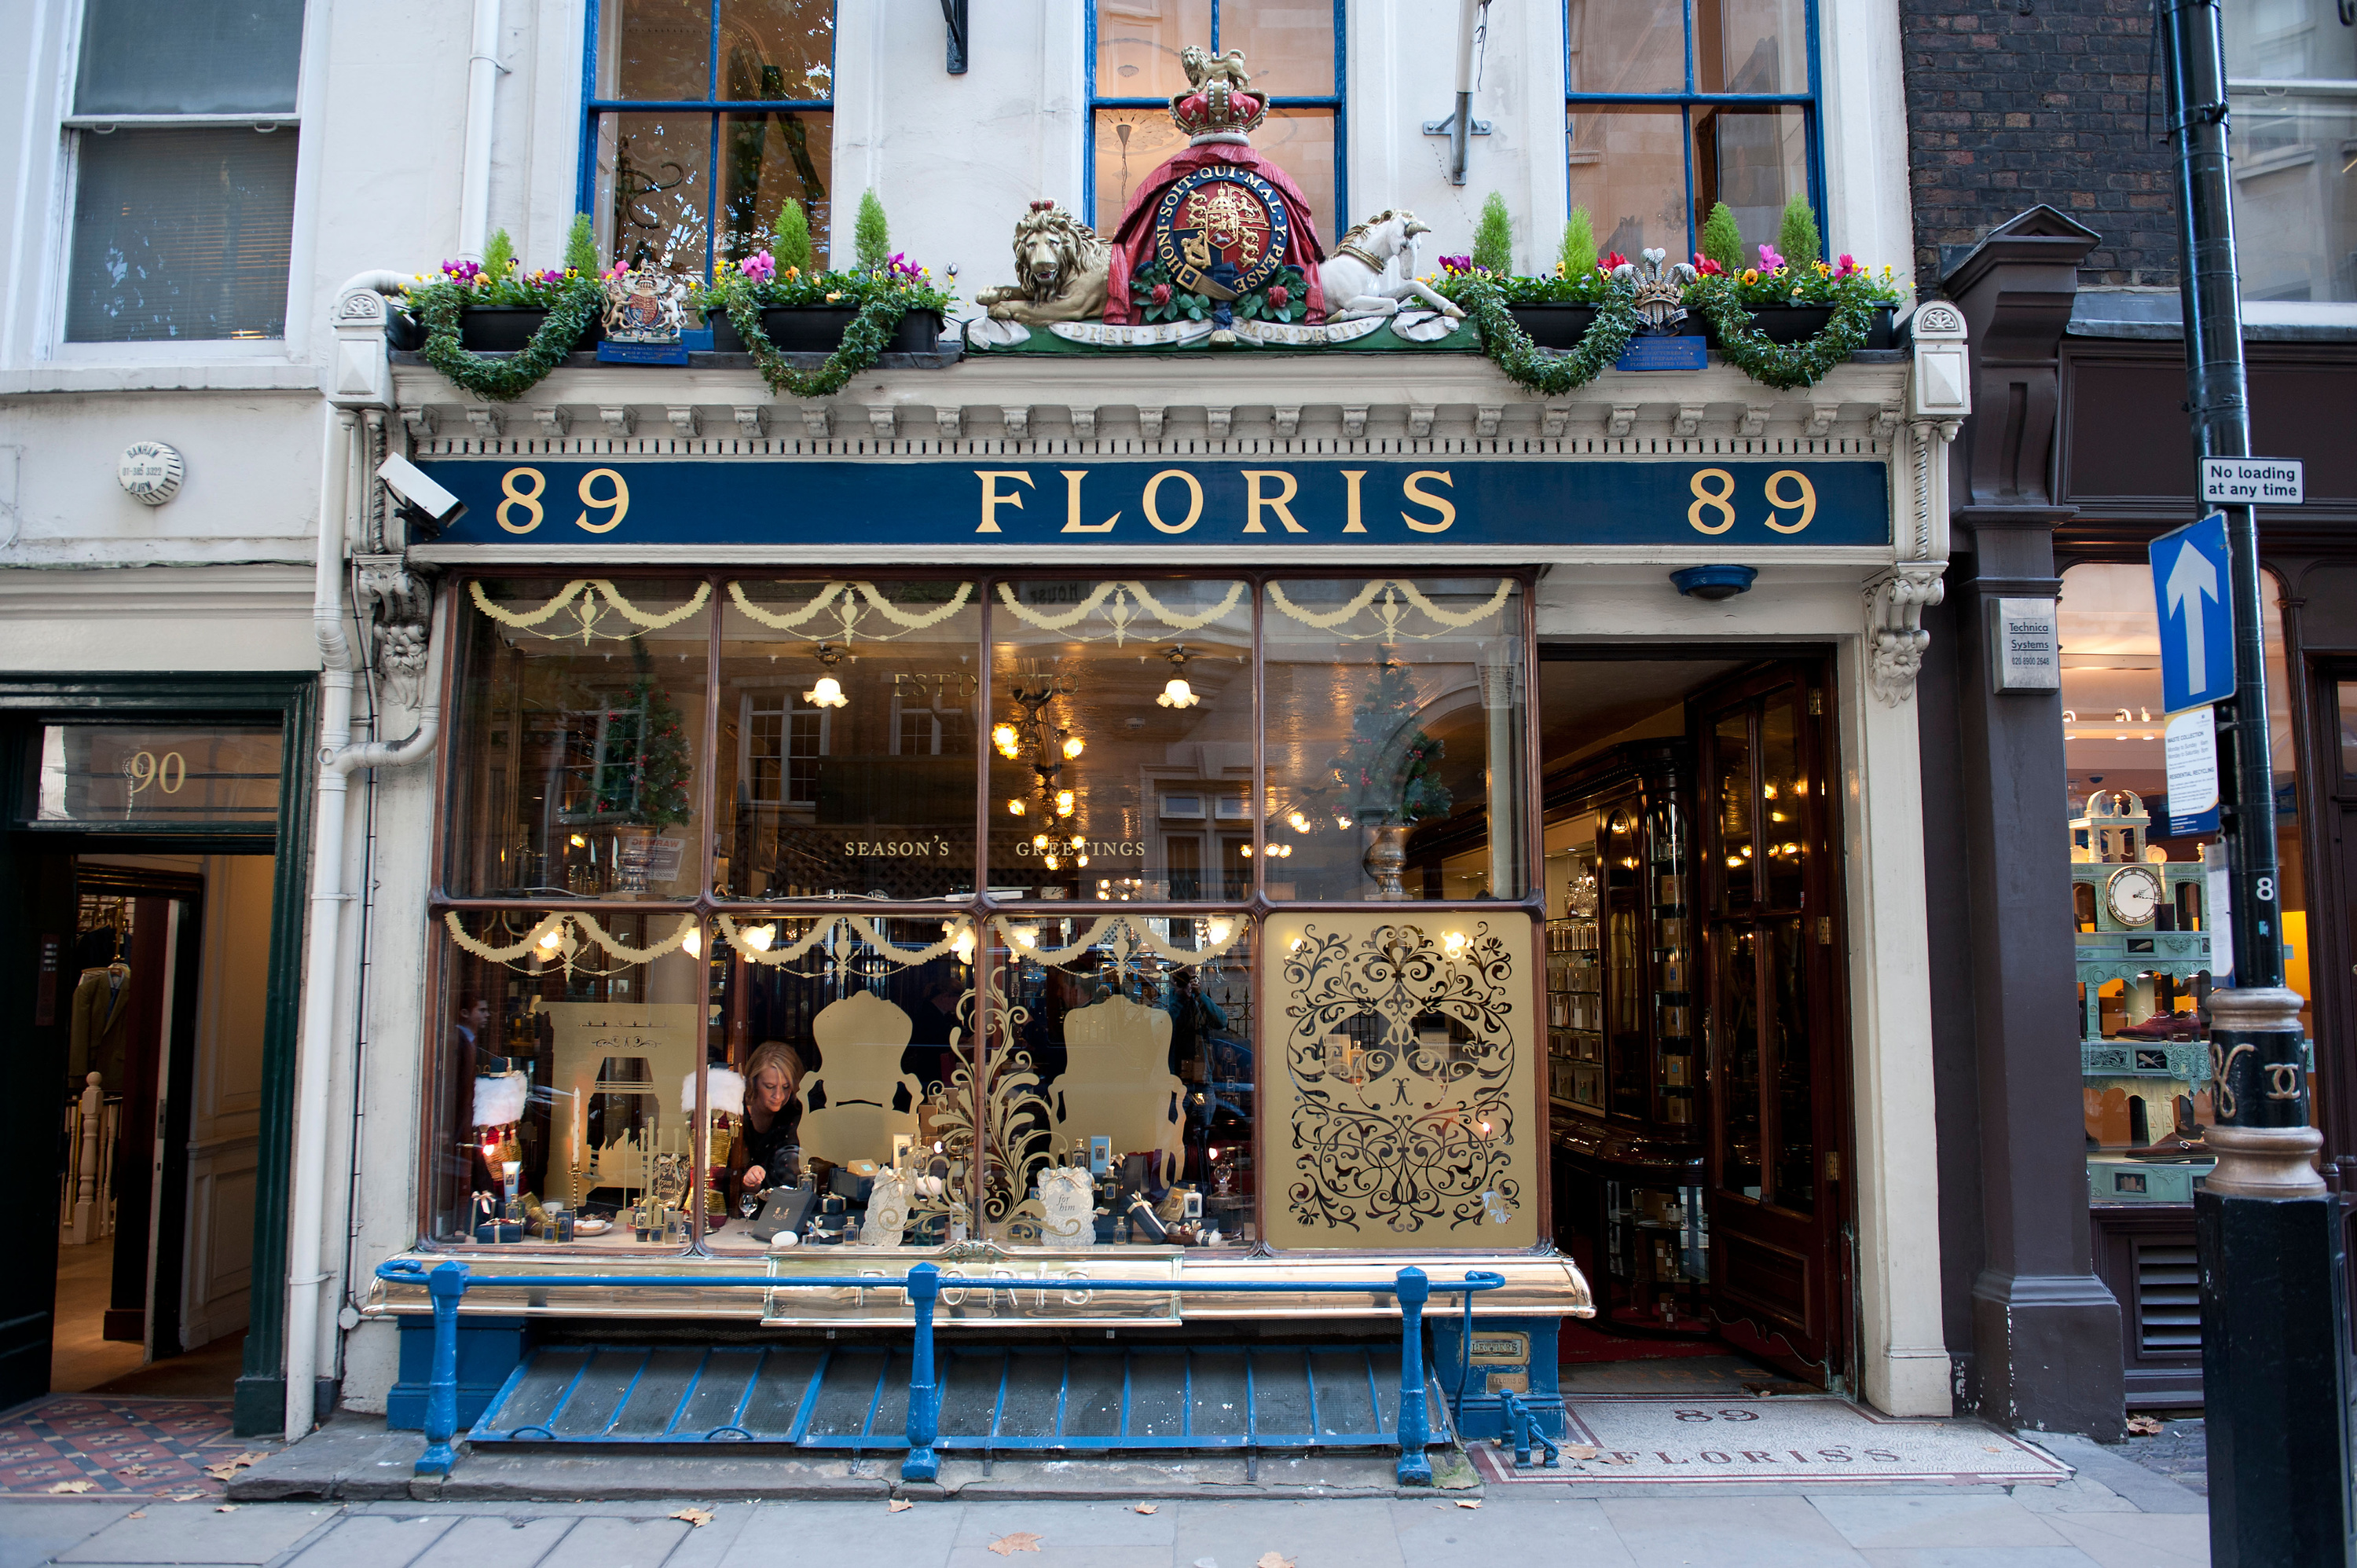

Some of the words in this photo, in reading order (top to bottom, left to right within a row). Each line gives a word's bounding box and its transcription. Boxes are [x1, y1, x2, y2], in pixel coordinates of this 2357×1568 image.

[1200, 166, 1237, 179] QUI
[1159, 175, 1192, 218] SOIT
[1244, 172, 1282, 214] MAL
[1274, 224, 1287, 236] Y
[1157, 224, 1183, 274] HONI
[1233, 244, 1286, 294] PENSE
[1071, 322, 1135, 343] DIEU
[1243, 322, 1291, 341] MON
[1298, 321, 1364, 342] DROIT
[126, 445, 159, 459] BANHAM
[145, 467, 162, 476] 3322
[2211, 465, 2232, 478] No
[2238, 466, 2295, 482] loading
[129, 481, 152, 493] ALARM
[2209, 482, 2224, 495] at
[2230, 485, 2257, 497] any
[2263, 483, 2297, 496] time
[973, 469, 1457, 534] FLORIS
[2009, 622, 2048, 632] Technica
[2011, 639, 2049, 651] Systems
[2012, 657, 2022, 665] 020
[2023, 657, 2036, 665] 8900
[2036, 657, 2049, 665] 2648
[893, 671, 979, 698] EST'D
[1006, 672, 1080, 702] 1730
[130, 751, 185, 794] 90
[845, 835, 949, 856] SEASON'S
[1016, 841, 1146, 856] GREETINGS
[2256, 877, 2275, 900] 8
[1057, 1194, 1071, 1206] for
[1058, 1203, 1075, 1211] him
[1472, 1343, 1517, 1352] LETTERS
[1673, 1409, 1760, 1423] 89
